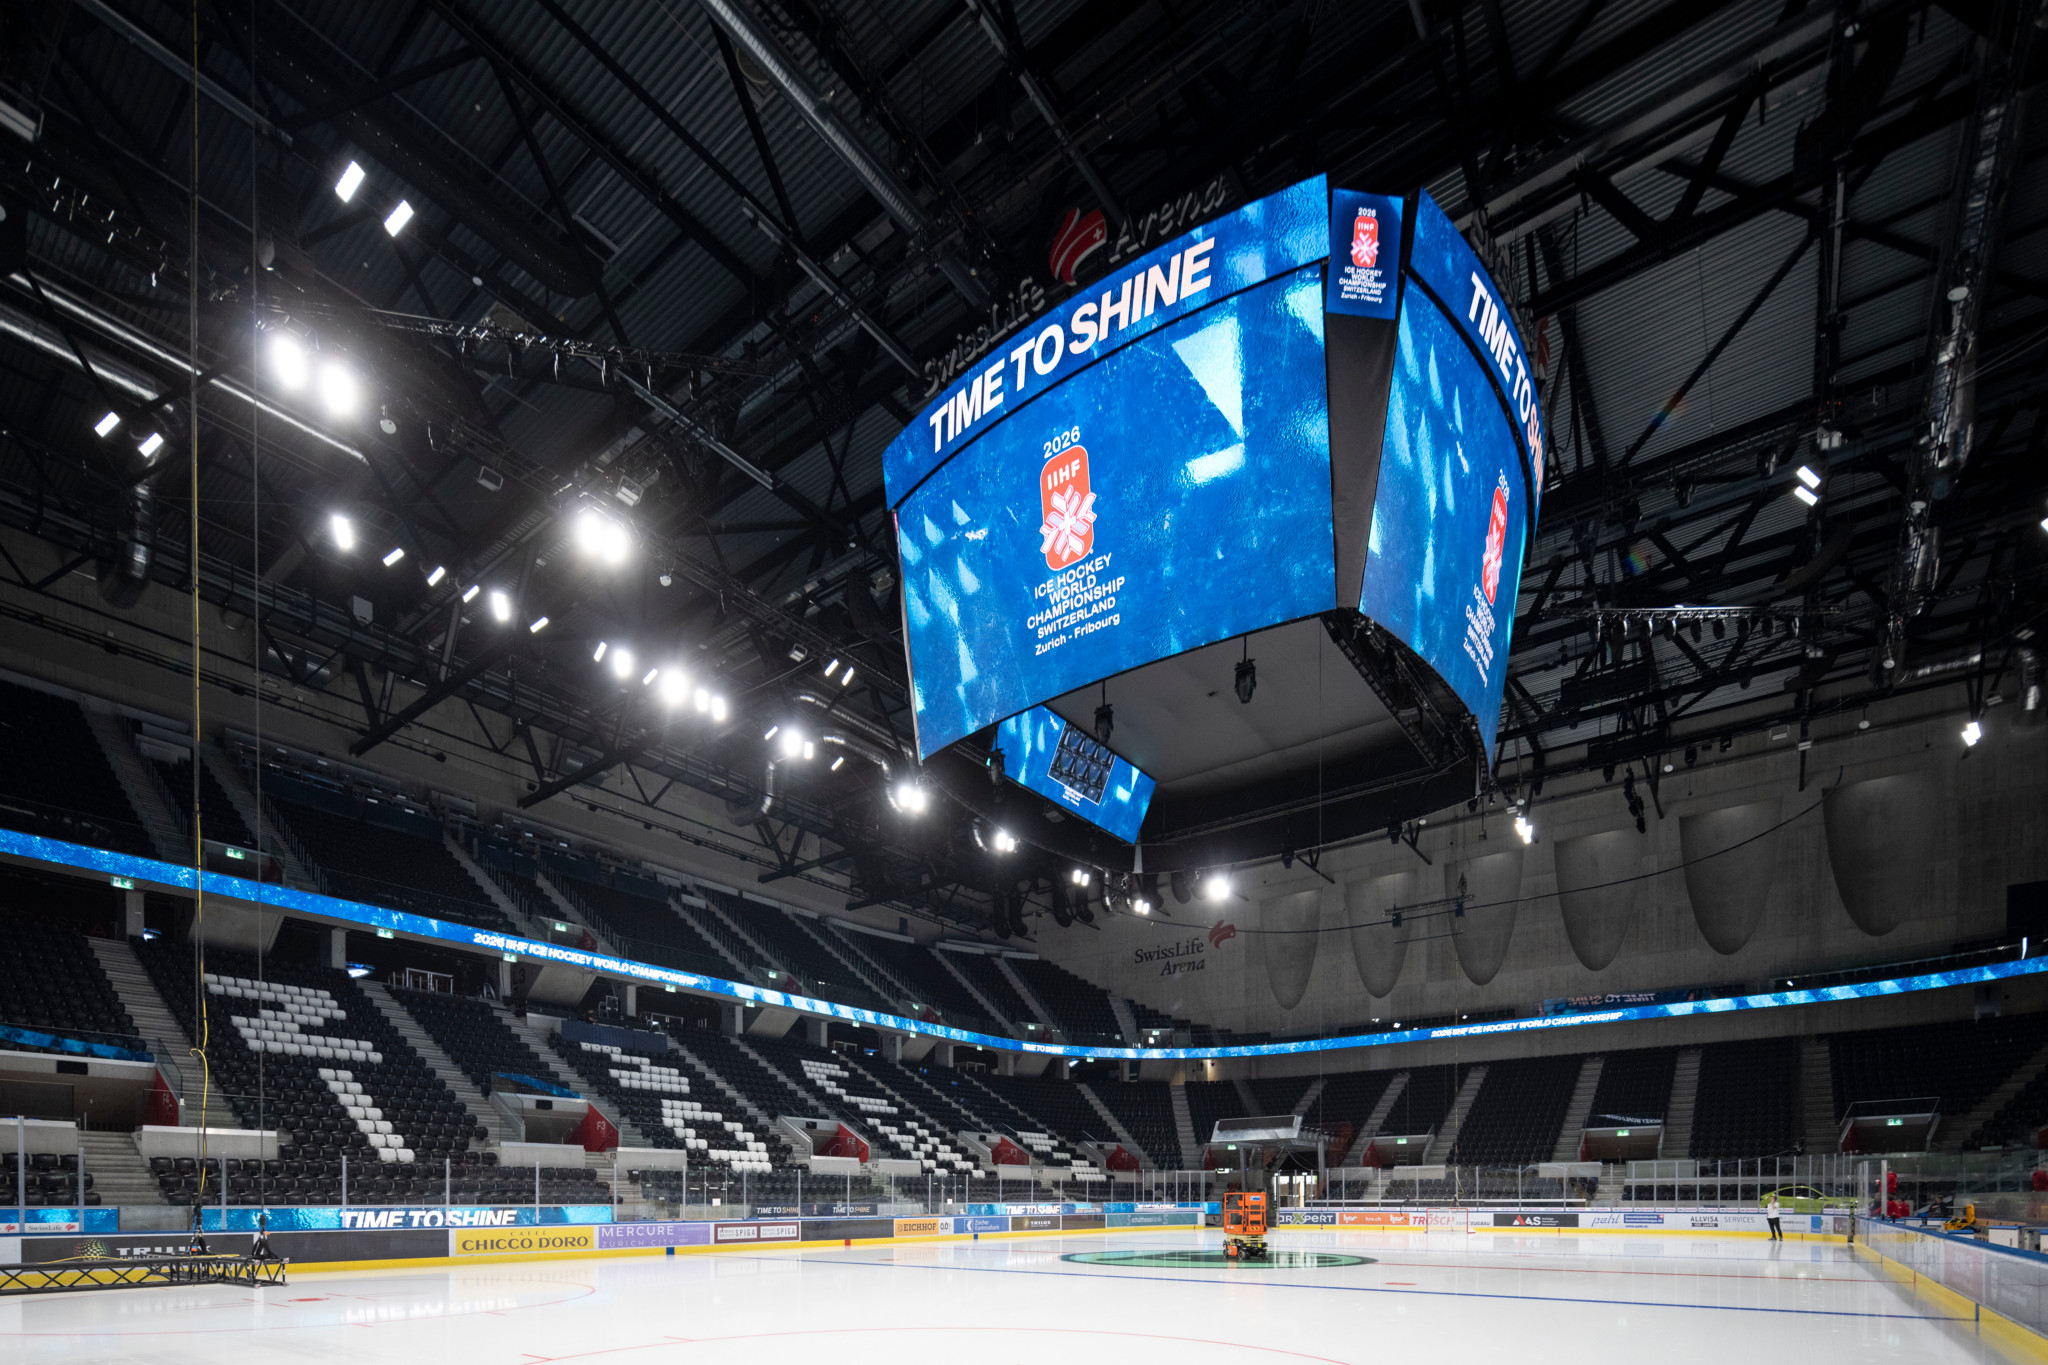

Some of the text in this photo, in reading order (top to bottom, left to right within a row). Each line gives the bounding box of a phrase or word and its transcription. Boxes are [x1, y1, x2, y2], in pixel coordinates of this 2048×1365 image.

[1358, 207, 1376, 217] 2026
[1344, 266, 1382, 277] ICE HOCKEY
[1351, 274, 1374, 282] WORLD
[1339, 278, 1386, 290] CHAMPIONSHIP
[1343, 285, 1381, 295] SWITZERLAND
[1341, 292, 1357, 300] Zurich
[1361, 294, 1382, 304] Fribourg
[929, 236, 1215, 454] TIME TO SHINE
[1468, 271, 1517, 383] TIME
[1513, 354, 1531, 424] TO
[1043, 426, 1081, 459] 2026
[1047, 458, 1081, 490] IIHF
[1034, 553, 1112, 599] ICE HOCKEY
[1049, 574, 1097, 606] WORLD
[1027, 576, 1125, 630] CHAMPIONSHIP
[1037, 596, 1116, 639] SWITZERLAND
[1035, 633, 1067, 656] Zurich
[1074, 613, 1121, 639] Fribourg
[1135, 938, 1204, 964] SwissLife
[473, 932, 699, 987] 2026 IIHF ICE HOCKEY WORLD CHAMPIONSHIP
[1160, 958, 1206, 976] Arena
[1468, 1025, 1483, 1034] ICE
[1483, 1022, 1519, 1033] HOCKEY
[1519, 1018, 1552, 1029] WORLD
[1551, 1012, 1623, 1026] CHAMPIONSHIP
[597, 1120, 605, 1130] F3
[847, 1137, 856, 1145] F2
[610, 1152, 616, 1160] F3
[772, 1206, 782, 1214] TO
[1006, 1205, 1060, 1215] TIME TO SHINE
[339, 1209, 517, 1228] TIME TO SHINE
[1412, 1213, 1455, 1226] TRÖSCH
[1724, 1216, 1756, 1224] SERVICES
[601, 1225, 675, 1238] MERCURE
[735, 1228, 756, 1237] SPIGA
[776, 1227, 796, 1236] SPIGA
[903, 1222, 937, 1232] EICHHOF
[461, 1236, 589, 1251] CHICCO D'ORO
